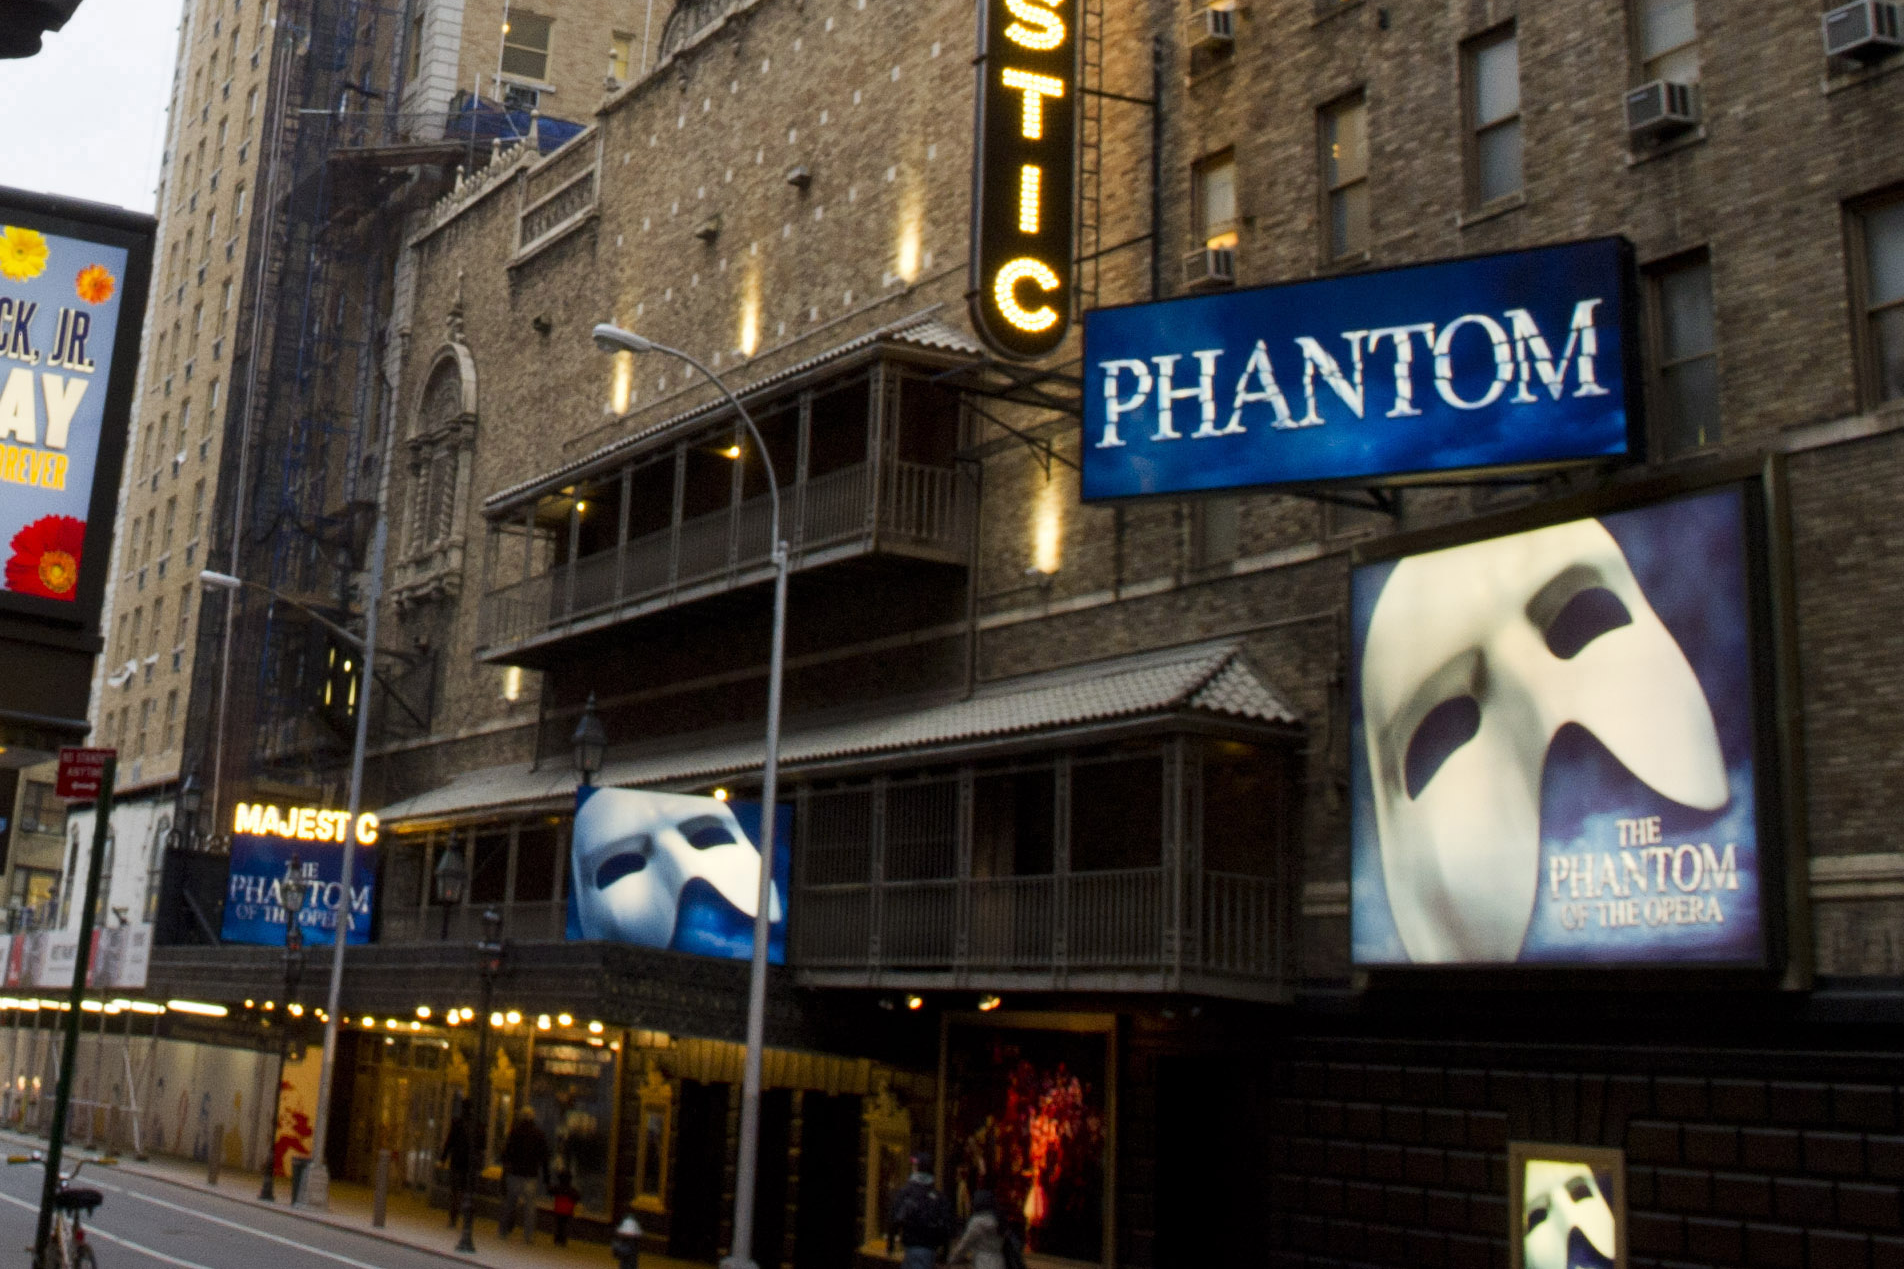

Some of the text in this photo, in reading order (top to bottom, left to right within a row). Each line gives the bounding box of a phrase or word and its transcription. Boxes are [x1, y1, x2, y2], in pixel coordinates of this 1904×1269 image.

[47, 307, 96, 373] JR.
[1095, 297, 1610, 449] PHANTOM
[234, 802, 380, 845] MAJESTC
[1615, 815, 1663, 848] THE
[1549, 842, 1739, 900] PHANTOM
[230, 874, 371, 914] PHATOM
[1561, 896, 1724, 930] OF THE OPERA
